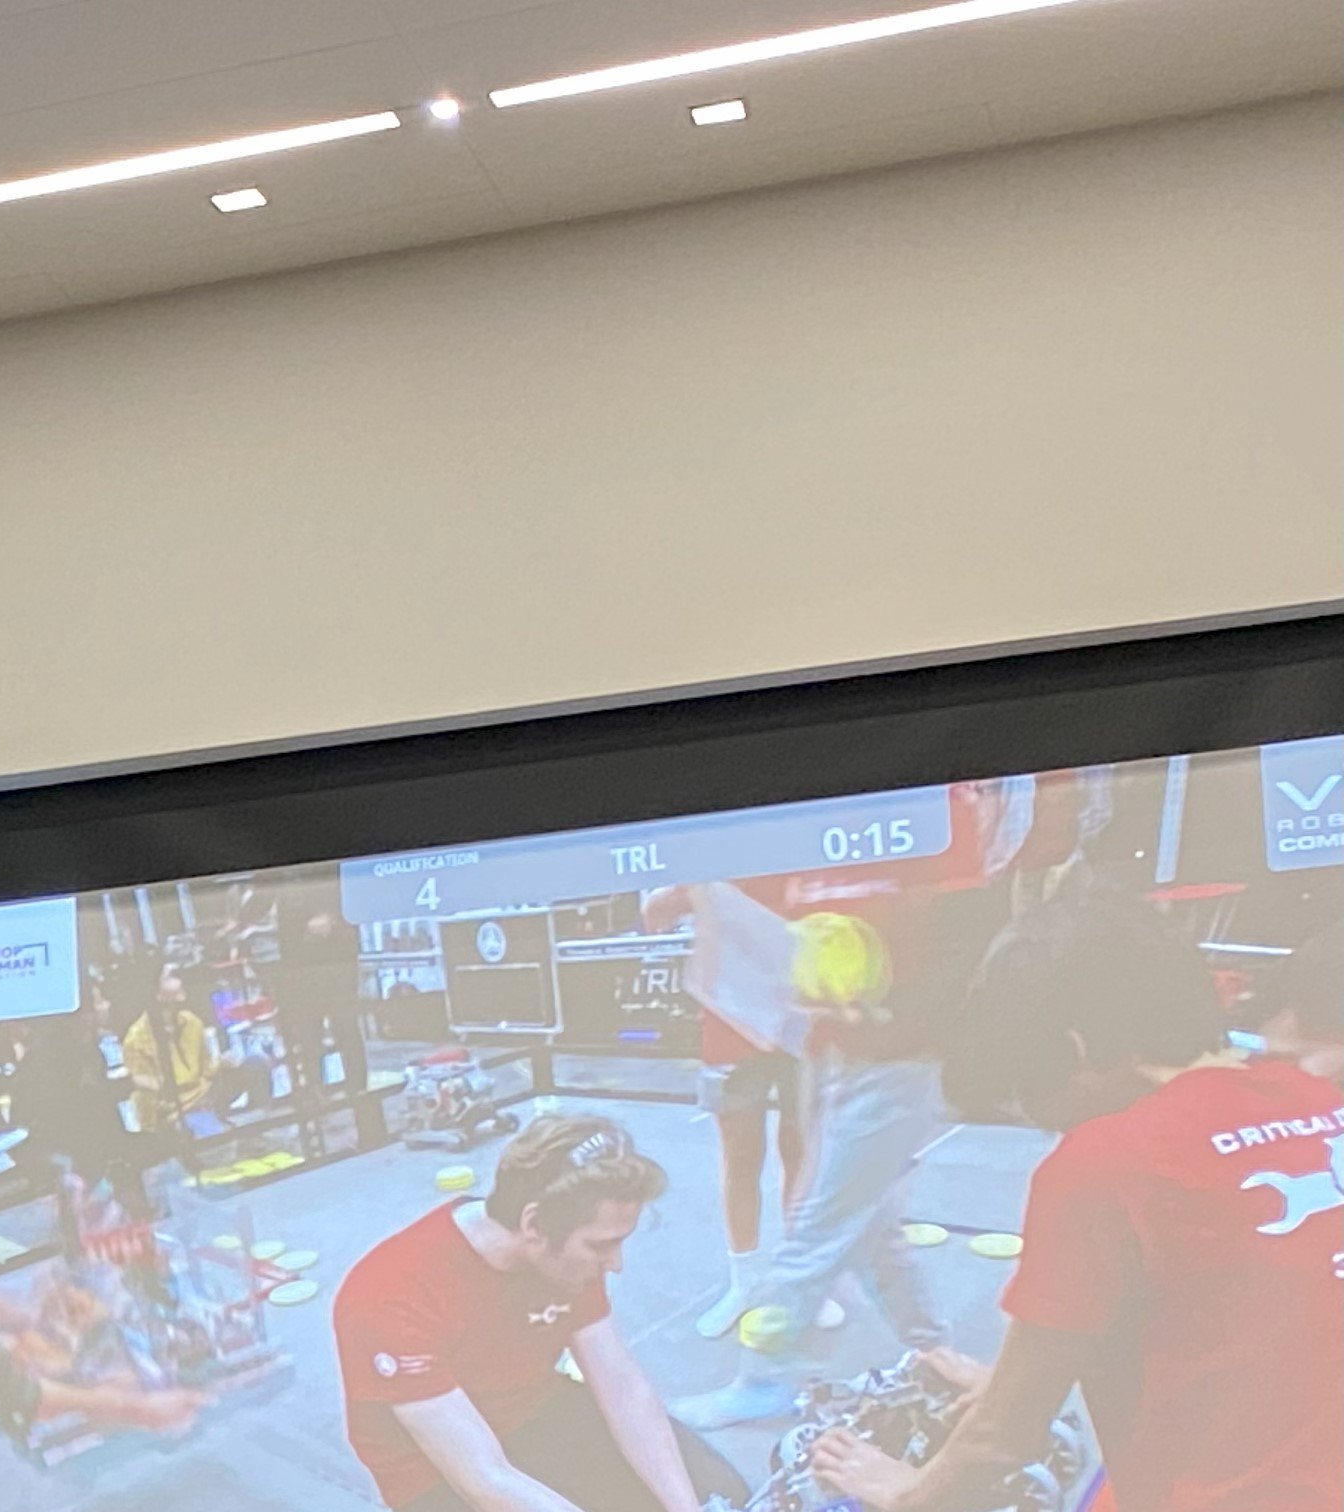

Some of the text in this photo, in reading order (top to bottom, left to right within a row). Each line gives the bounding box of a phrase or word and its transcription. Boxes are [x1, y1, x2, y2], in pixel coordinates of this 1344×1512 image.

[822, 818, 914, 862] 0:15
[374, 851, 479, 876] QUALIFICATION
[610, 843, 666, 875] TRL
[414, 877, 441, 910] 4
